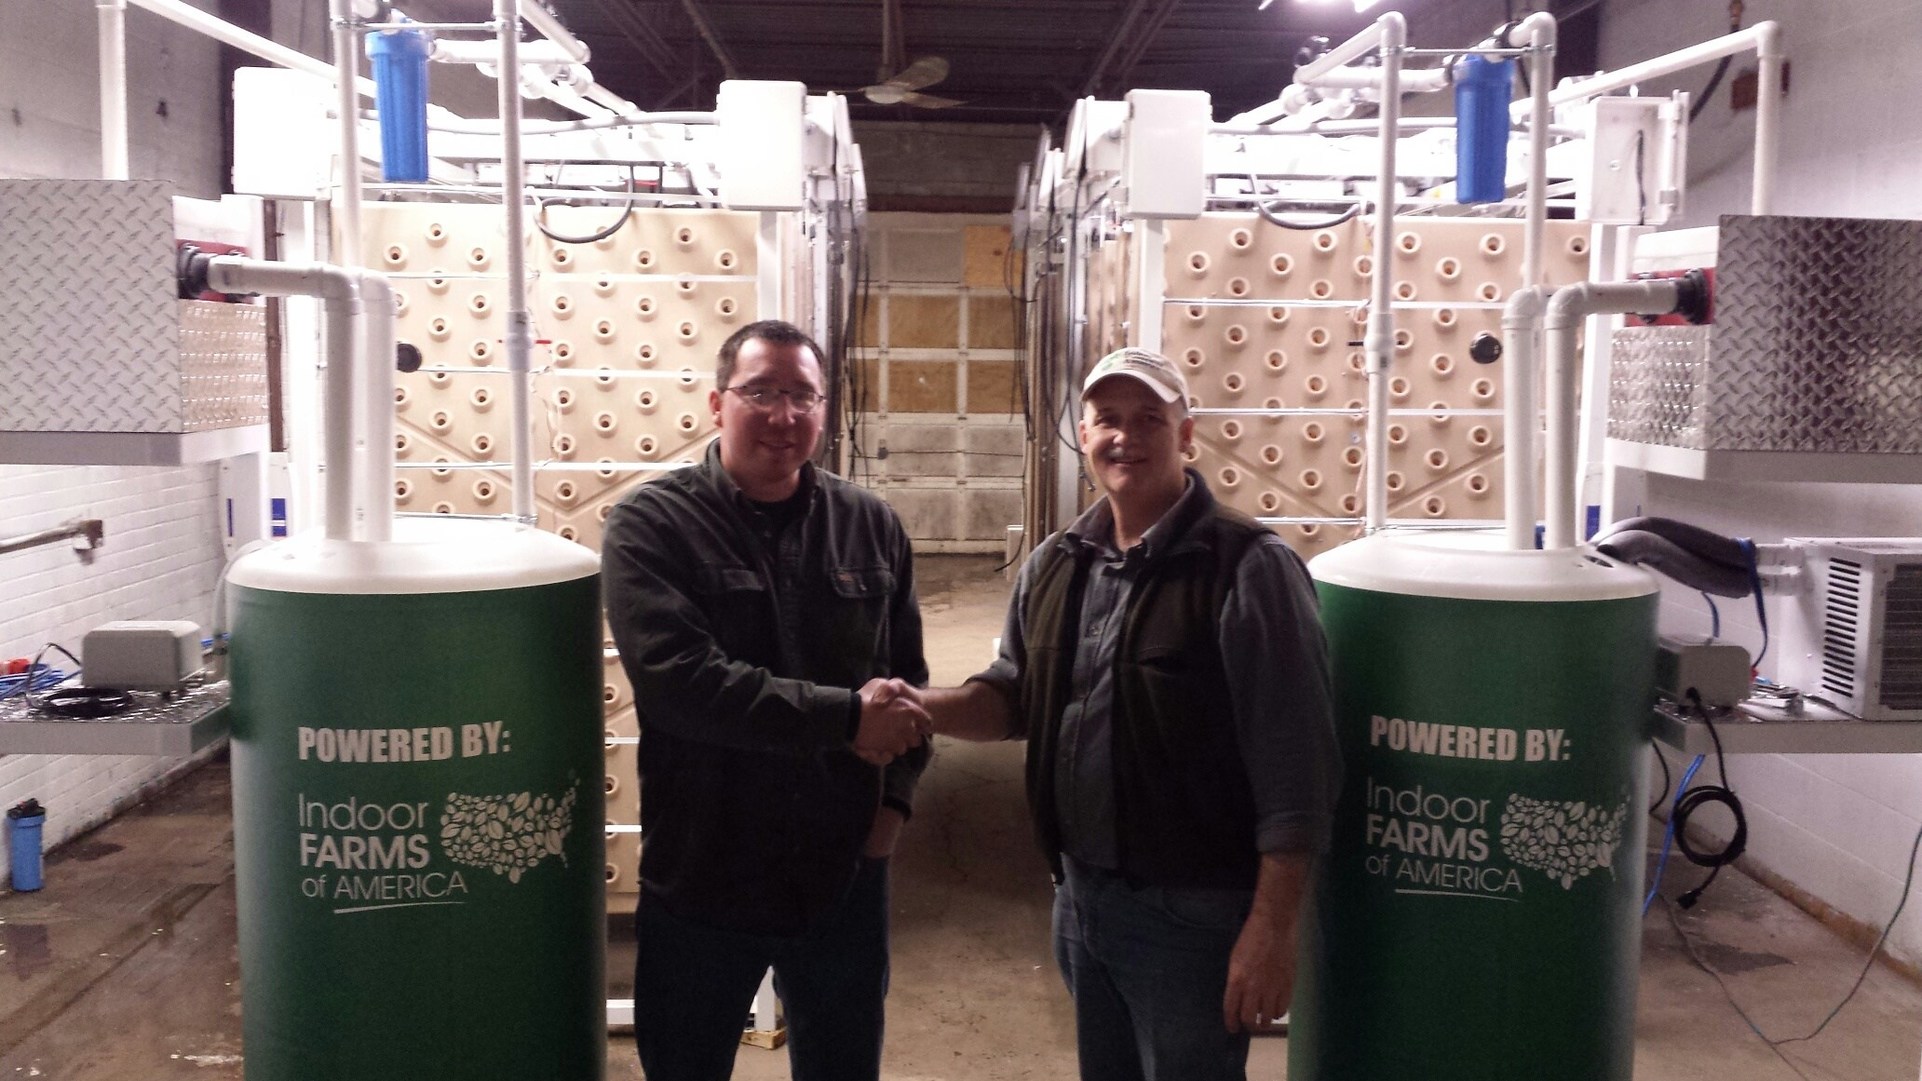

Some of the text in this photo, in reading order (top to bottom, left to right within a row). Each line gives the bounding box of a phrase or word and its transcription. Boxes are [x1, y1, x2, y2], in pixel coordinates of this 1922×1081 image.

[298, 720, 511, 763] POWERED BY:
[1370, 715, 1571, 762] POWERED BY:
[299, 793, 429, 830] Indoor
[1366, 776, 1491, 824] Indoor
[300, 833, 429, 870] FARMS
[1366, 813, 1489, 862] FARMS
[301, 870, 468, 900] of AMERICA
[1365, 854, 1523, 893] of AMERICA
